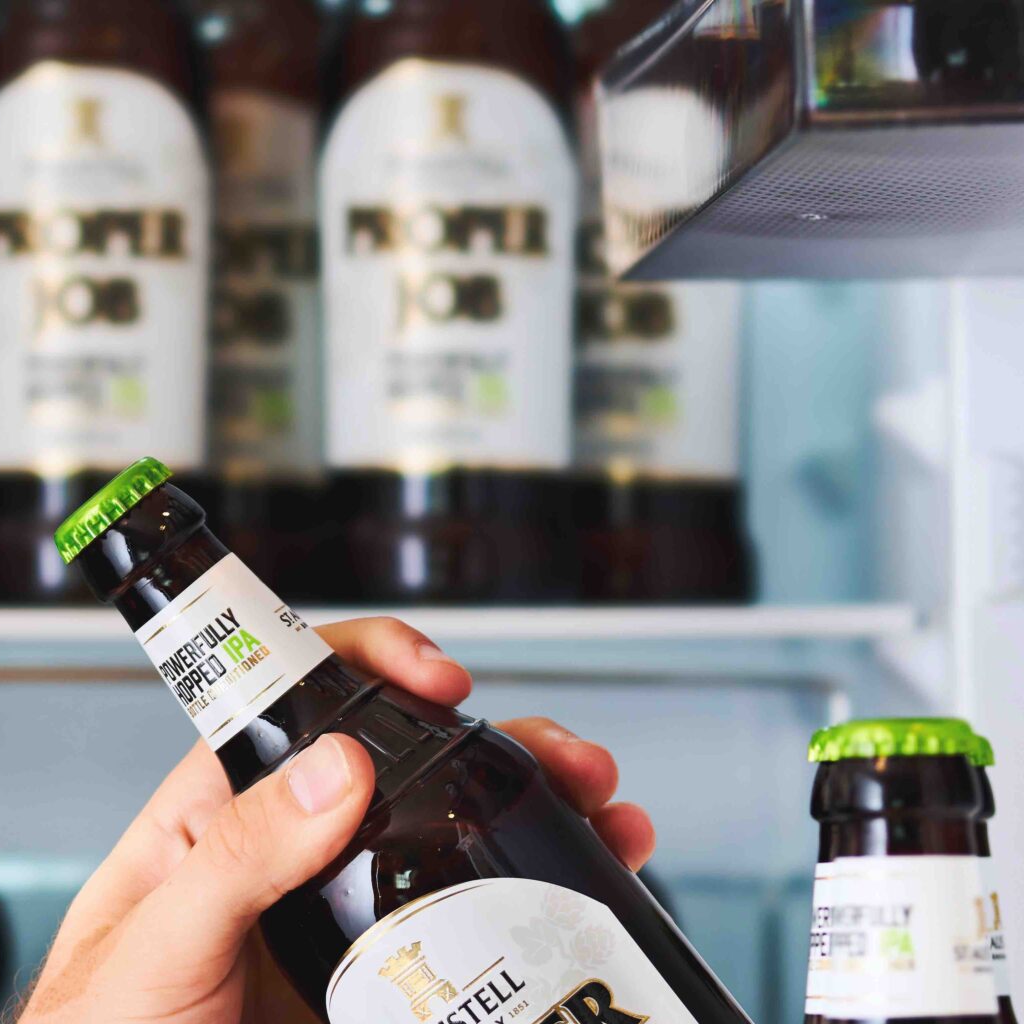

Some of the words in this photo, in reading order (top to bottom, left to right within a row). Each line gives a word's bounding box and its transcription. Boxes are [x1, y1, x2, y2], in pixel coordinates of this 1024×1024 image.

[158, 607, 240, 684] POWERFULLY
[172, 653, 227, 707] HOPPED
[221, 628, 262, 664] IPA
[508, 1000, 529, 1019] 1851
